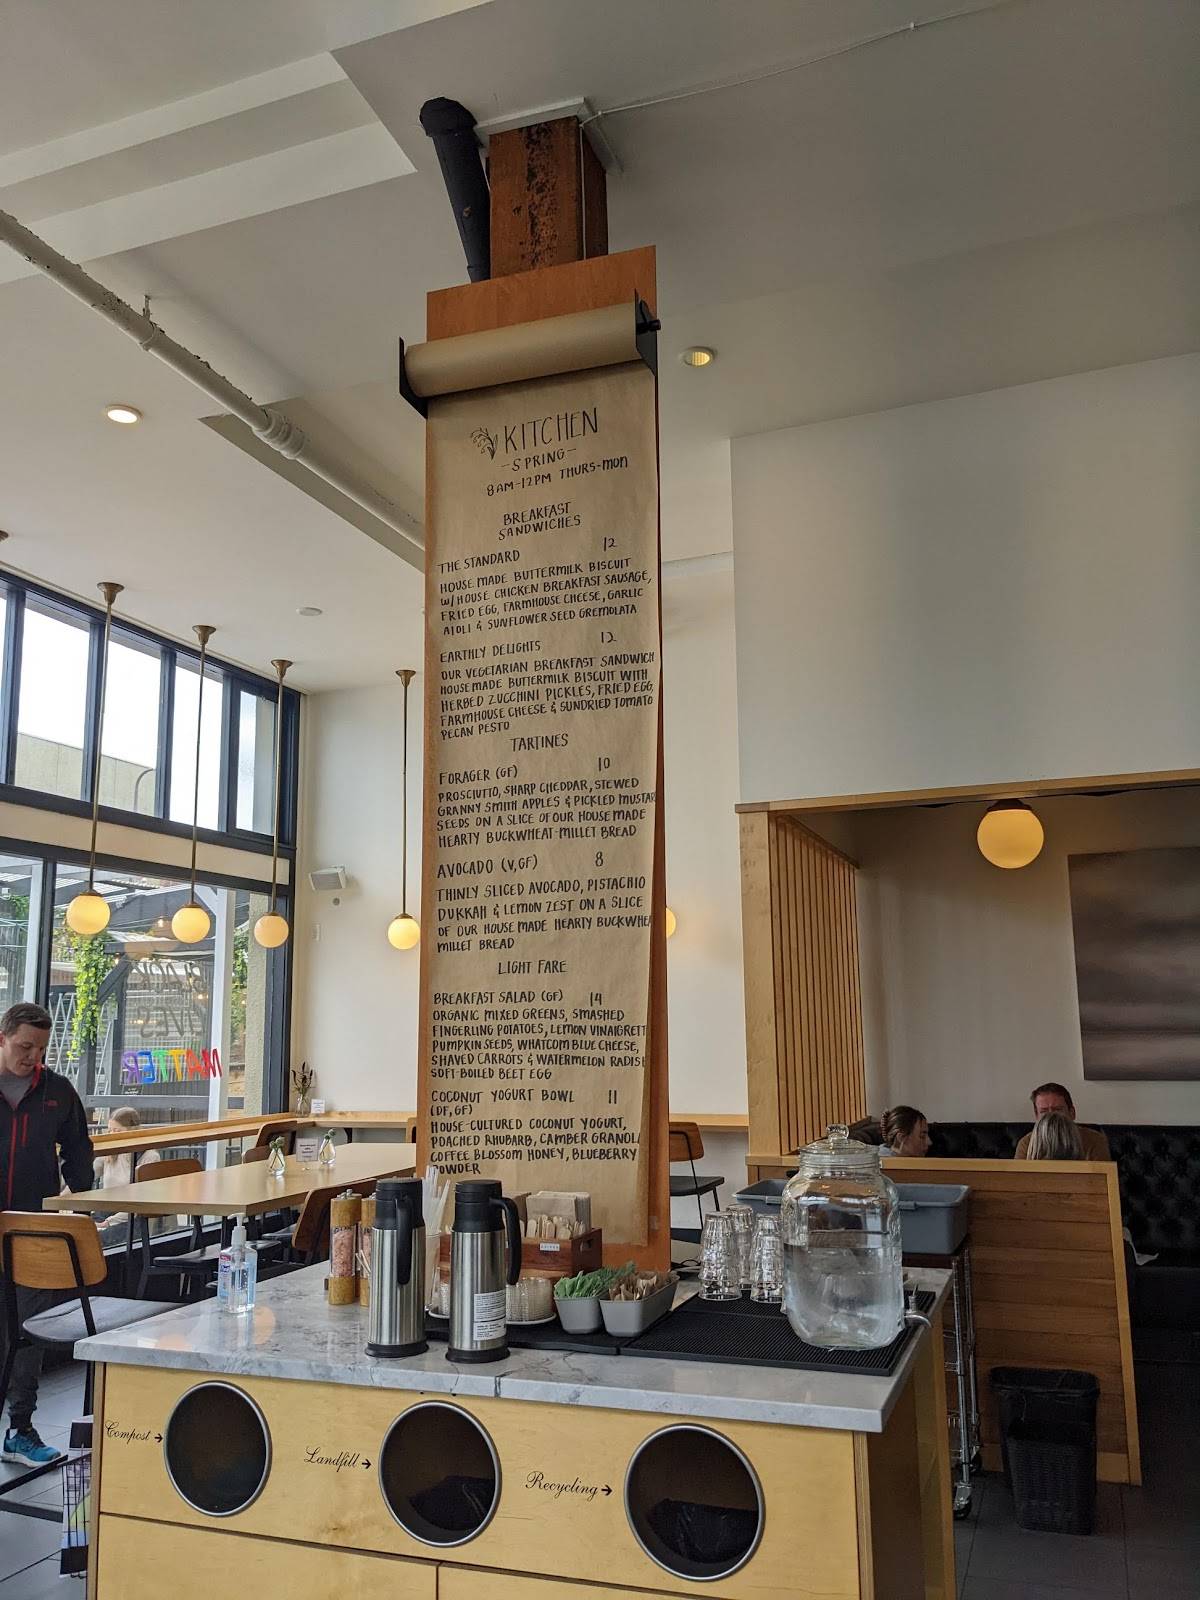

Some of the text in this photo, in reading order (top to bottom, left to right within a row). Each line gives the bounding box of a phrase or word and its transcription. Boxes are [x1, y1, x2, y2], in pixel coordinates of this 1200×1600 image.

[504, 407, 598, 454] KITCHEN
[487, 473, 552, 496] 8AM-12PM
[504, 502, 571, 525] BREAKFAST
[499, 515, 580, 540] SANDWICHES
[604, 537, 617, 552] 12
[438, 550, 520, 574] THE STANDARD
[514, 564, 583, 581] BUTTERMILK
[589, 558, 631, 572] BISCUIT
[495, 584, 538, 598] CHICKEN
[544, 576, 601, 592] BREAKFAST
[441, 608, 474, 621] FRIED
[504, 595, 560, 612] FARMHOUSE
[608, 588, 644, 600] GARLIC
[444, 624, 470, 635] AIOLI
[488, 613, 547, 629] SUNFLOWER
[550, 610, 575, 621] SEED
[579, 604, 637, 618] GREMOLATA
[601, 632, 616, 643] 12
[440, 640, 540, 662] EARTHLY DELIGHTS
[441, 652, 654, 680] OUR VEGETARIAN BREAKFAST SANDWICH
[509, 673, 570, 688] BUTTERMILK
[575, 670, 617, 682] BISCUIT
[620, 669, 647, 681] WITH
[441, 696, 483, 712] HERBED
[489, 689, 539, 705] ZUCCHINI
[598, 682, 630, 695] FRIED
[440, 708, 505, 726] FARMHOUSE
[508, 704, 547, 718] CHEESE
[560, 699, 610, 712] SUNDRIED
[615, 695, 653, 708] TOMATO
[441, 722, 509, 740] PECAN PESTO
[510, 734, 568, 752] TARTINES
[440, 764, 517, 784] FORAGER (GF)
[599, 757, 610, 772] 10
[503, 783, 536, 796] SHARP
[595, 778, 639, 790] STEWED
[438, 803, 480, 816] GRANNY
[485, 801, 517, 812] SMITH
[522, 796, 560, 809] APPLES
[574, 795, 615, 807] PICKLED
[437, 818, 469, 831] SEEDS
[476, 816, 491, 827] ON
[497, 816, 503, 826] A
[507, 813, 534, 825] SLICE
[540, 813, 549, 822] OF
[553, 812, 573, 822] OUR
[439, 832, 479, 848] HEARTY
[601, 825, 636, 839] BREAD
[596, 851, 603, 866] 8
[437, 860, 493, 878] AVOCADO
[436, 886, 478, 902] THINLY
[484, 884, 524, 898] SLICED
[588, 876, 645, 891] PISTACHIO
[438, 906, 486, 921] DUKKAH
[504, 902, 541, 915] LEMON
[546, 900, 574, 912] ZEST
[580, 899, 594, 910] ON
[599, 898, 606, 910] A
[612, 896, 643, 908] SLICE
[438, 926, 450, 936] OF
[457, 924, 478, 936] OUR
[555, 917, 592, 930] HEARTY
[437, 938, 514, 952] MILLET BREAD
[498, 960, 568, 974] LIGHT FARE
[434, 989, 563, 1005] BREAKFAST SALAD (GF)
[590, 992, 602, 1007] 14
[433, 1010, 479, 1021] ORGANIC
[484, 1010, 519, 1021] MIXED
[573, 1009, 624, 1020] SMASHED
[433, 1025, 493, 1037] FINGERLING
[551, 1024, 586, 1035] LEMON
[433, 1040, 481, 1052] PUMPKIN
[518, 1039, 569, 1050] WHATCOM
[572, 1040, 596, 1050] BLUE
[432, 1053, 474, 1066] SHAVED
[478, 1053, 523, 1065] CARROTS
[536, 1054, 605, 1067] WATERMELON
[499, 1068, 525, 1080] BEET
[530, 1068, 552, 1079] EGG
[432, 1088, 575, 1103] COCONUT YOGURT BOWL
[609, 1090, 617, 1104] 11
[530, 1118, 575, 1129] COCONUT
[431, 1136, 480, 1148] POACHED
[540, 1132, 588, 1145] CAMBER
[431, 1150, 470, 1162] COFFEE
[474, 1149, 522, 1160] BLOSSOM
[572, 1148, 637, 1160] BLUEBERRY
[105, 1420, 151, 1444] Compost
[304, 1446, 358, 1472] Landfill
[526, 1471, 598, 1502] Recycling
